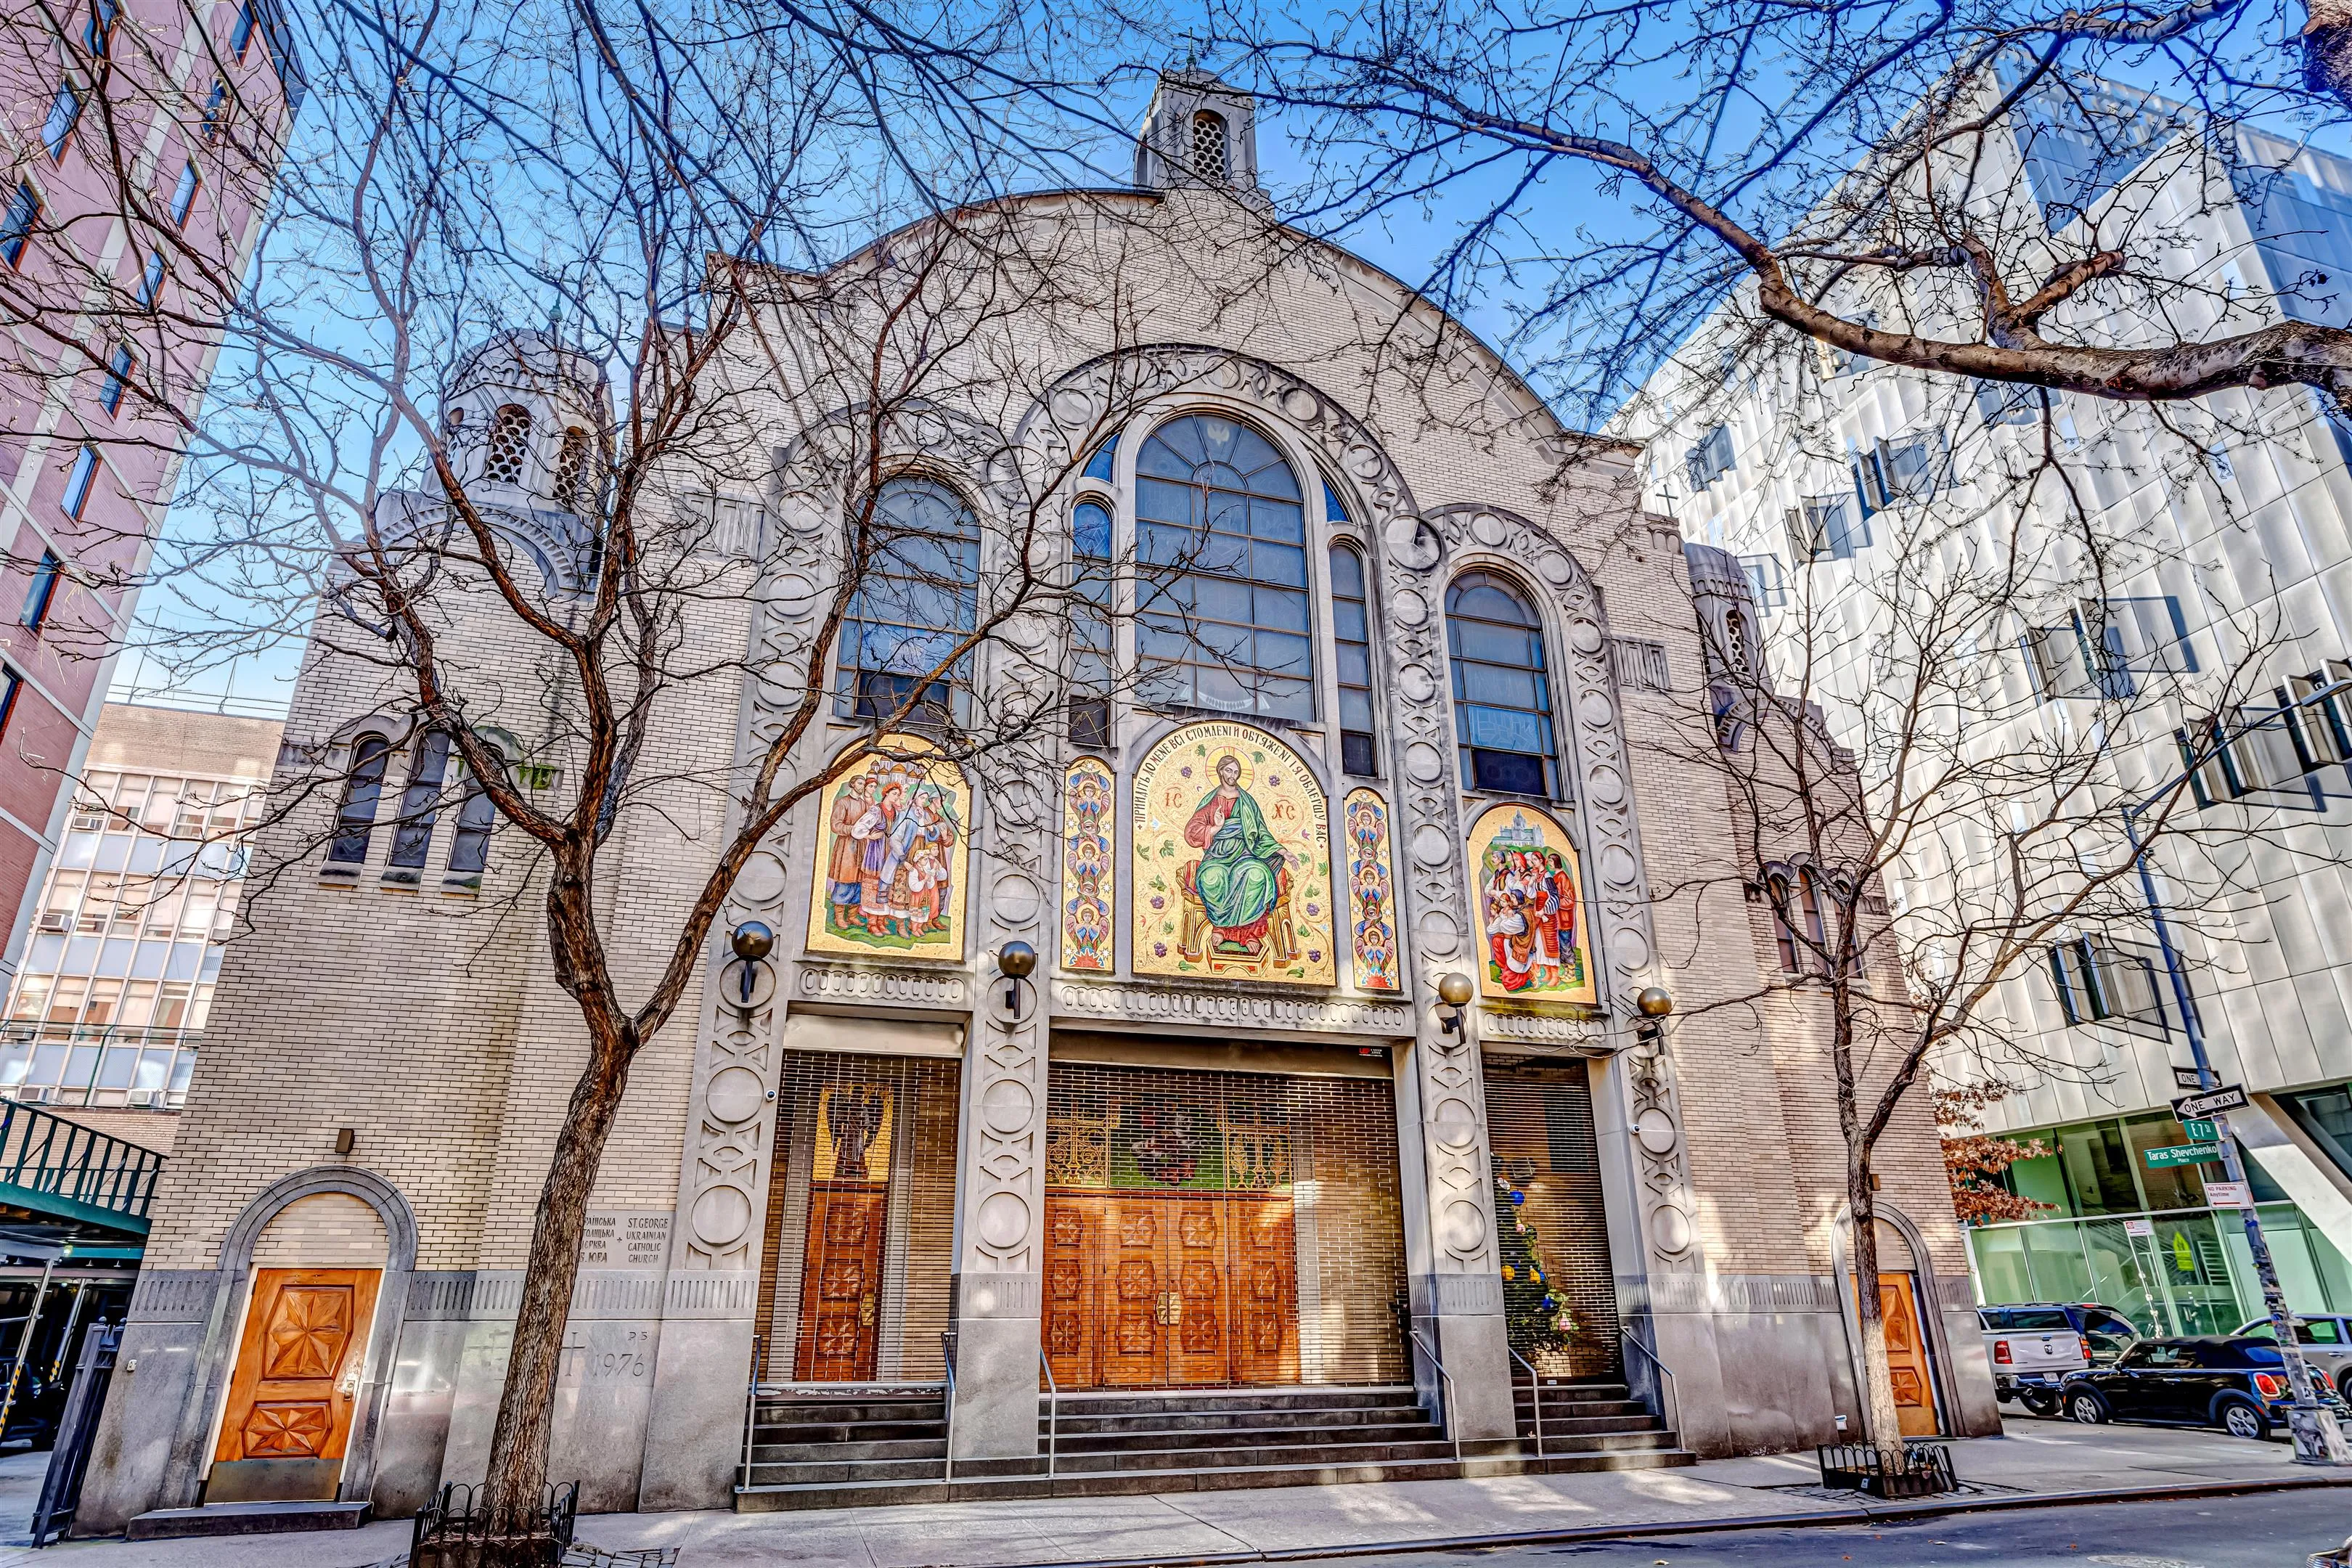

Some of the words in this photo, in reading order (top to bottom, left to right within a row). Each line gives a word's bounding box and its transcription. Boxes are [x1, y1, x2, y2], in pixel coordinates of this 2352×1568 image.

[1143, 762, 1156, 778] ДО
[1315, 823, 1327, 842] ВАС
[2181, 1074, 2197, 1083] ONE
[2184, 1101, 2205, 1113] ONE
[2213, 1093, 2235, 1106] WAY
[2190, 1123, 2198, 1137] E
[2197, 1123, 2204, 1138] 7
[2147, 1151, 2169, 1161] Taras
[2170, 1145, 2217, 1158] Shevchenko
[626, 1231, 667, 1241] UKRAINIAN
[627, 1242, 662, 1251] CATHOLIC
[628, 1254, 658, 1264] CHURCH
[594, 1353, 645, 1377] 1976
